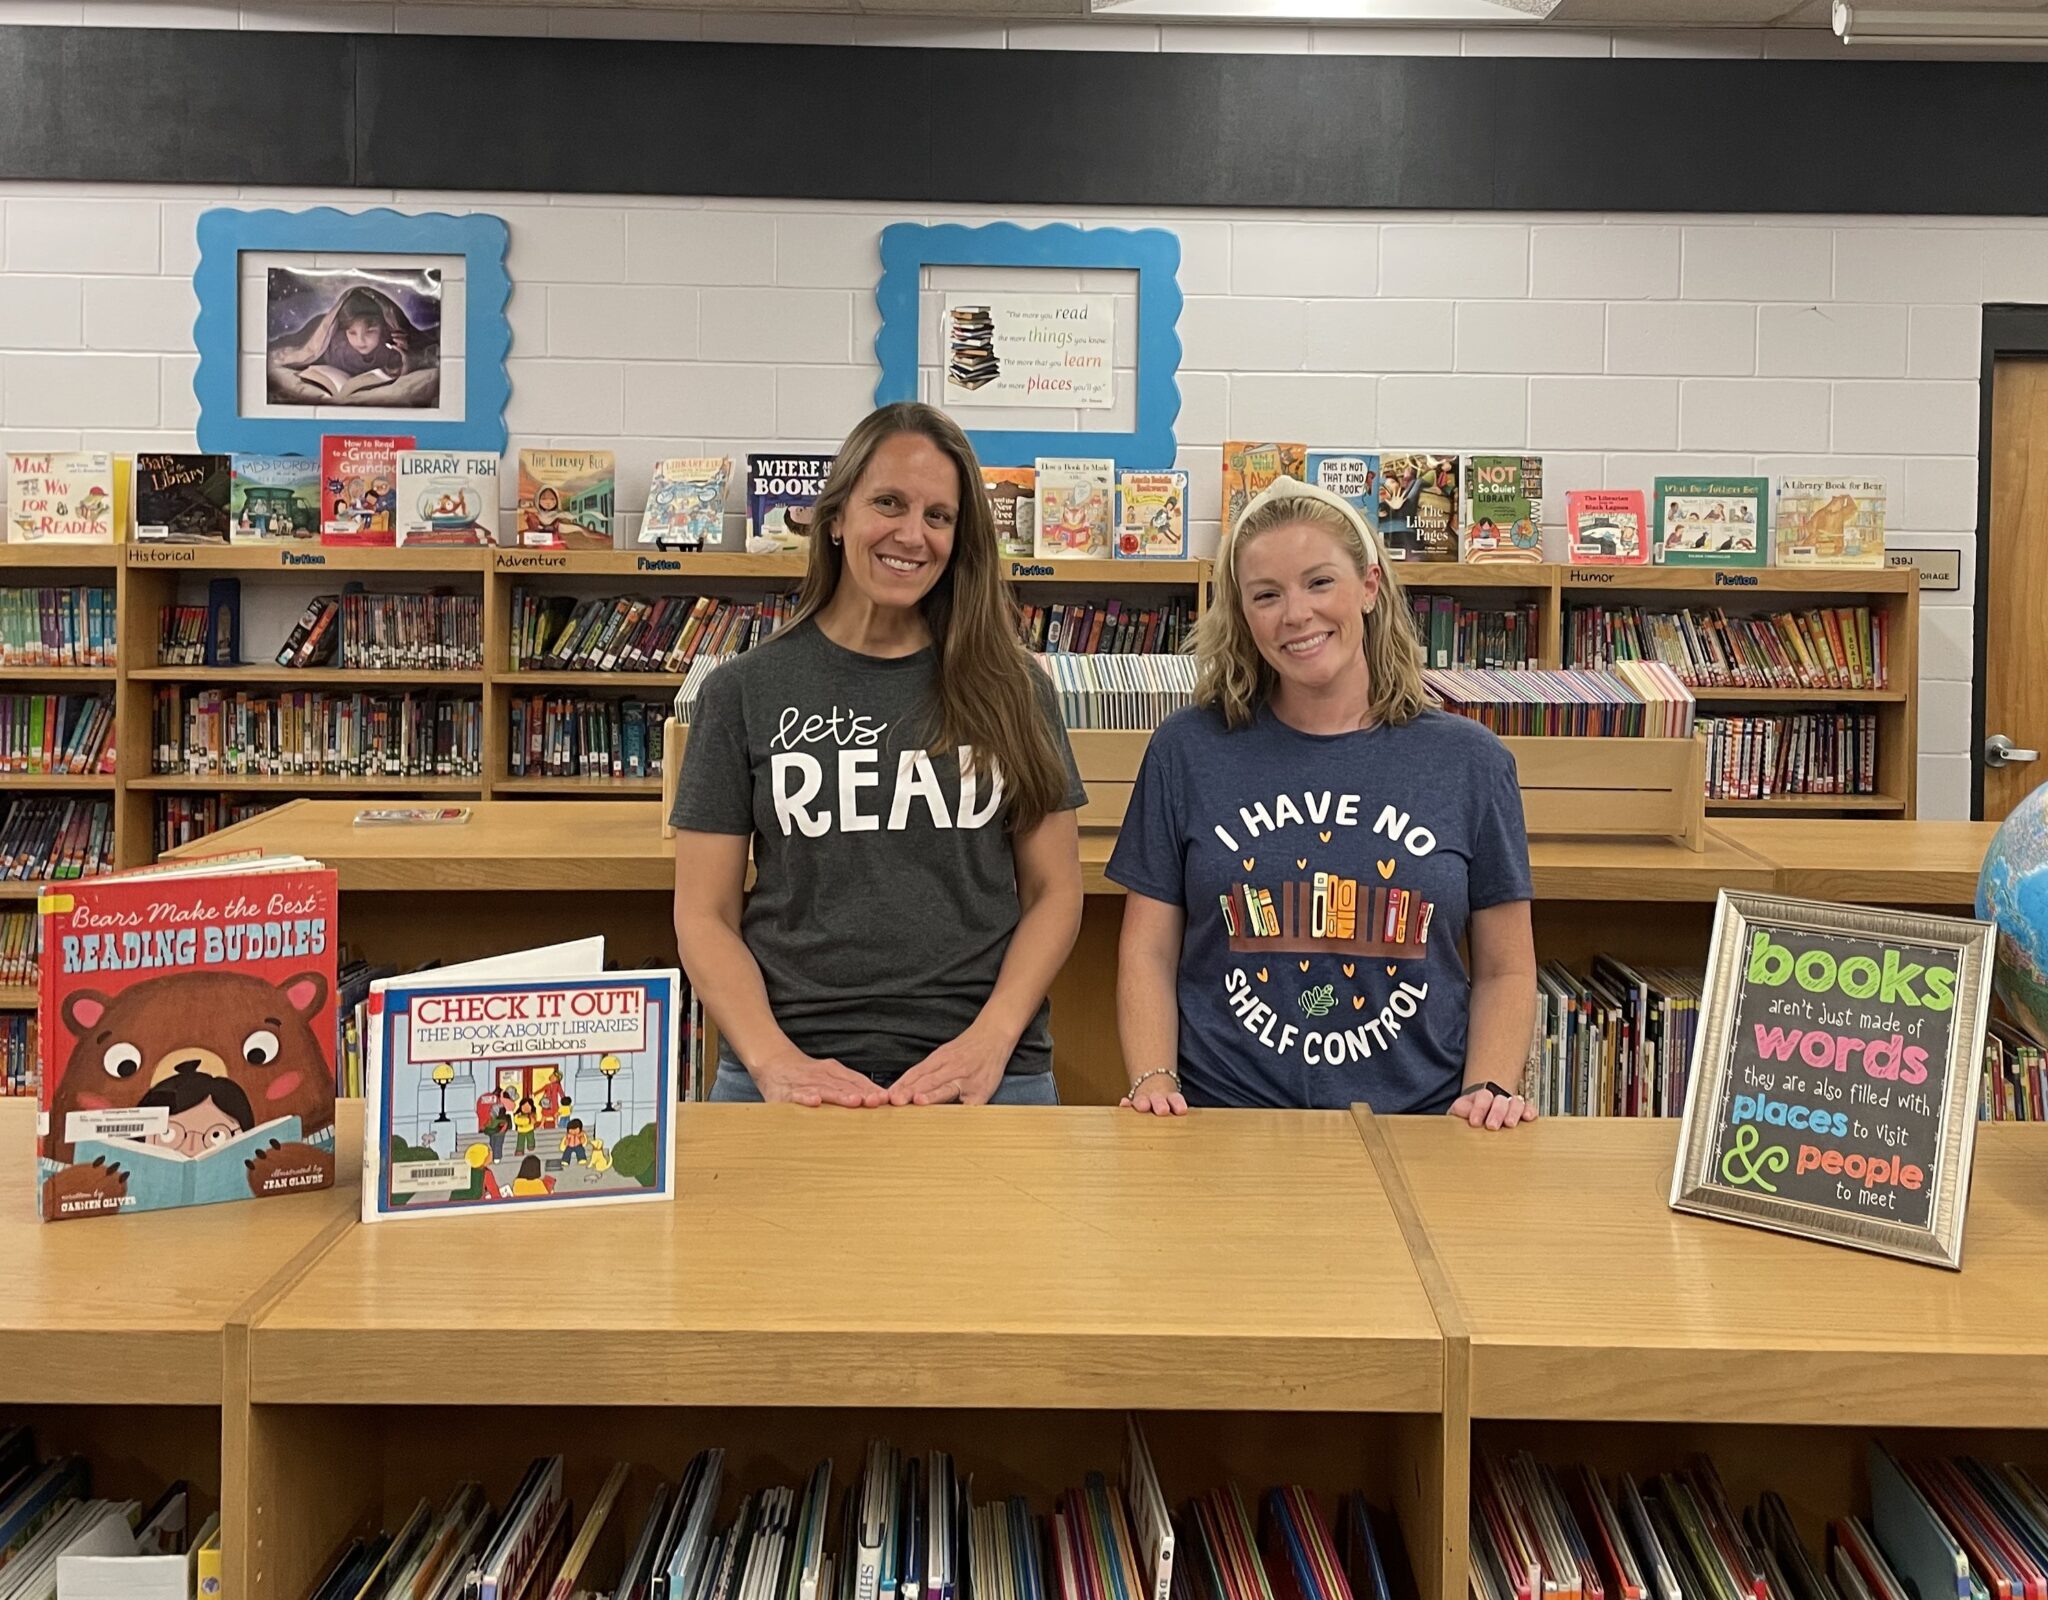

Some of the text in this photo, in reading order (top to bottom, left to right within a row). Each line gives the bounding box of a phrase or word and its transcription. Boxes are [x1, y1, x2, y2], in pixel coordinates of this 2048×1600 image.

[1040, 313, 1053, 321] you
[1056, 304, 1088, 320] read
[1028, 327, 1073, 349] things
[1074, 337, 1087, 346] you
[1034, 358, 1048, 366] that
[1064, 352, 1102, 368] learn
[1027, 374, 1072, 395] places
[344, 440, 394, 448] How to Read
[348, 448, 397, 460] Grandm
[532, 454, 546, 468] THE
[550, 454, 584, 471] LIBRARY
[141, 455, 174, 471] Bats
[402, 459, 496, 476] LIBRARY FISH
[757, 460, 820, 477] WHERE
[1323, 463, 1364, 471] THIS IS NOT
[152, 466, 206, 492] Library
[1323, 473, 1364, 482] THAT KIND
[1478, 466, 1517, 484] NOT
[45, 479, 70, 495] WAY
[1327, 484, 1359, 494] OF BOOK
[1478, 484, 1516, 494] So Quiet
[1792, 482, 1824, 491] Library
[1826, 482, 1846, 490] Book
[1849, 482, 1860, 490] for
[1863, 482, 1882, 490] Bear
[1478, 494, 1516, 503] LIBRARY
[1422, 505, 1444, 517] The
[41, 516, 107, 535] READERS
[1406, 516, 1449, 533] Library
[1416, 529, 1449, 544] Pages
[129, 549, 195, 562] Historical
[282, 552, 326, 564] Fiction
[496, 554, 567, 568] Adventure
[638, 557, 681, 570] Fiction
[1890, 556, 1913, 566] 139J
[1012, 563, 1054, 576] Fiction
[1570, 570, 1615, 583] Humor
[1715, 572, 1758, 586] Fiction
[770, 706, 888, 750] let's
[771, 745, 1005, 838] READ
[1214, 790, 1437, 857] I HAVE NO
[72, 893, 317, 929] Bears Make the Best
[62, 918, 327, 974] READING BUDDIES
[1748, 931, 1957, 1012] books
[418, 990, 640, 1025] CHECK IT OUT!
[1225, 967, 1428, 1066] SHELF CONTROL
[1768, 999, 1925, 1038] aren't just made of
[418, 1018, 640, 1042] THE BOOK ABOUT LIBRARIES
[471, 1038, 587, 1056] by Gail Gibbons
[1754, 1023, 1930, 1086] words
[1744, 1064, 1930, 1117] they are also filled with
[1732, 1093, 1910, 1148] places to visit
[1721, 1124, 1925, 1193] & people
[271, 1164, 323, 1178] illustrated by
[263, 1177, 288, 1190] JEAN
[61, 1196, 136, 1213] CARMEN OLIVER
[1836, 1181, 1897, 1211] to meet
